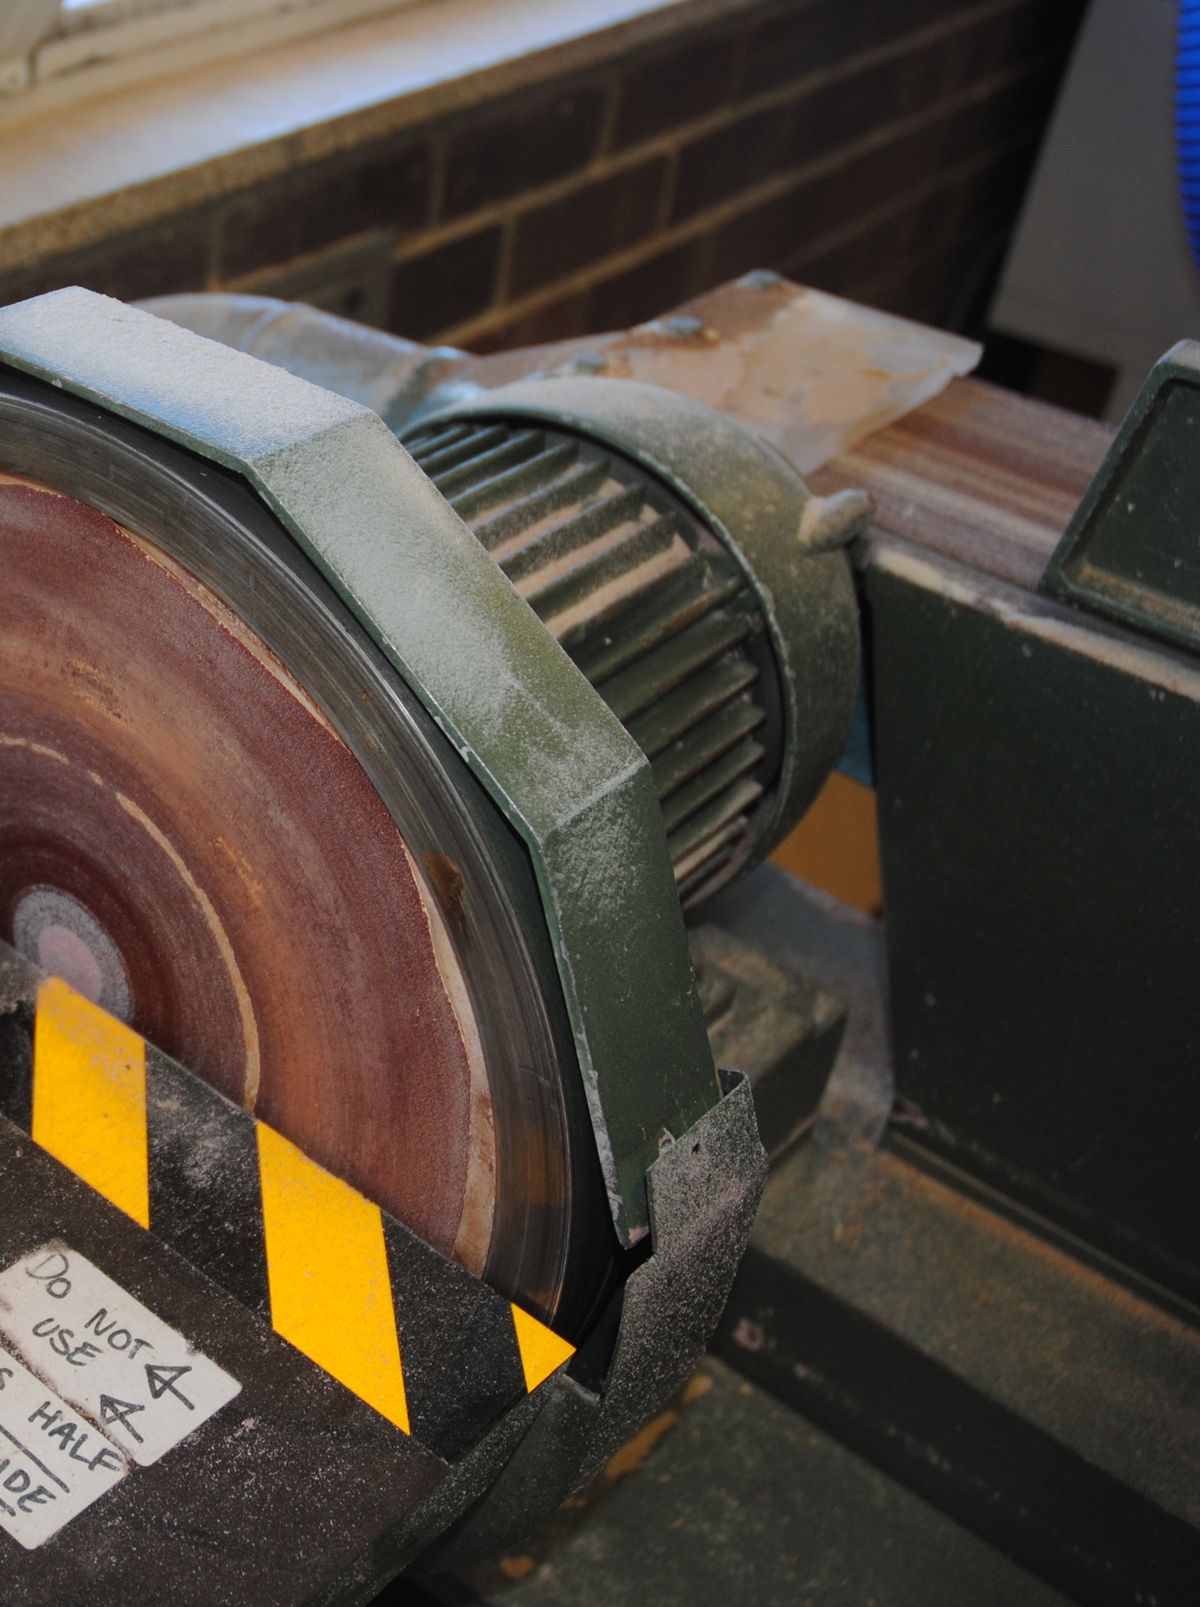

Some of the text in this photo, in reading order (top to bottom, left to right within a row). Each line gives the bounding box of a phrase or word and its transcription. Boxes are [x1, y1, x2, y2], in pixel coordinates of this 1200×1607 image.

[32, 1317, 104, 1367] USE
[84, 1308, 154, 1360] NOT
[28, 1401, 121, 1472] HALF
